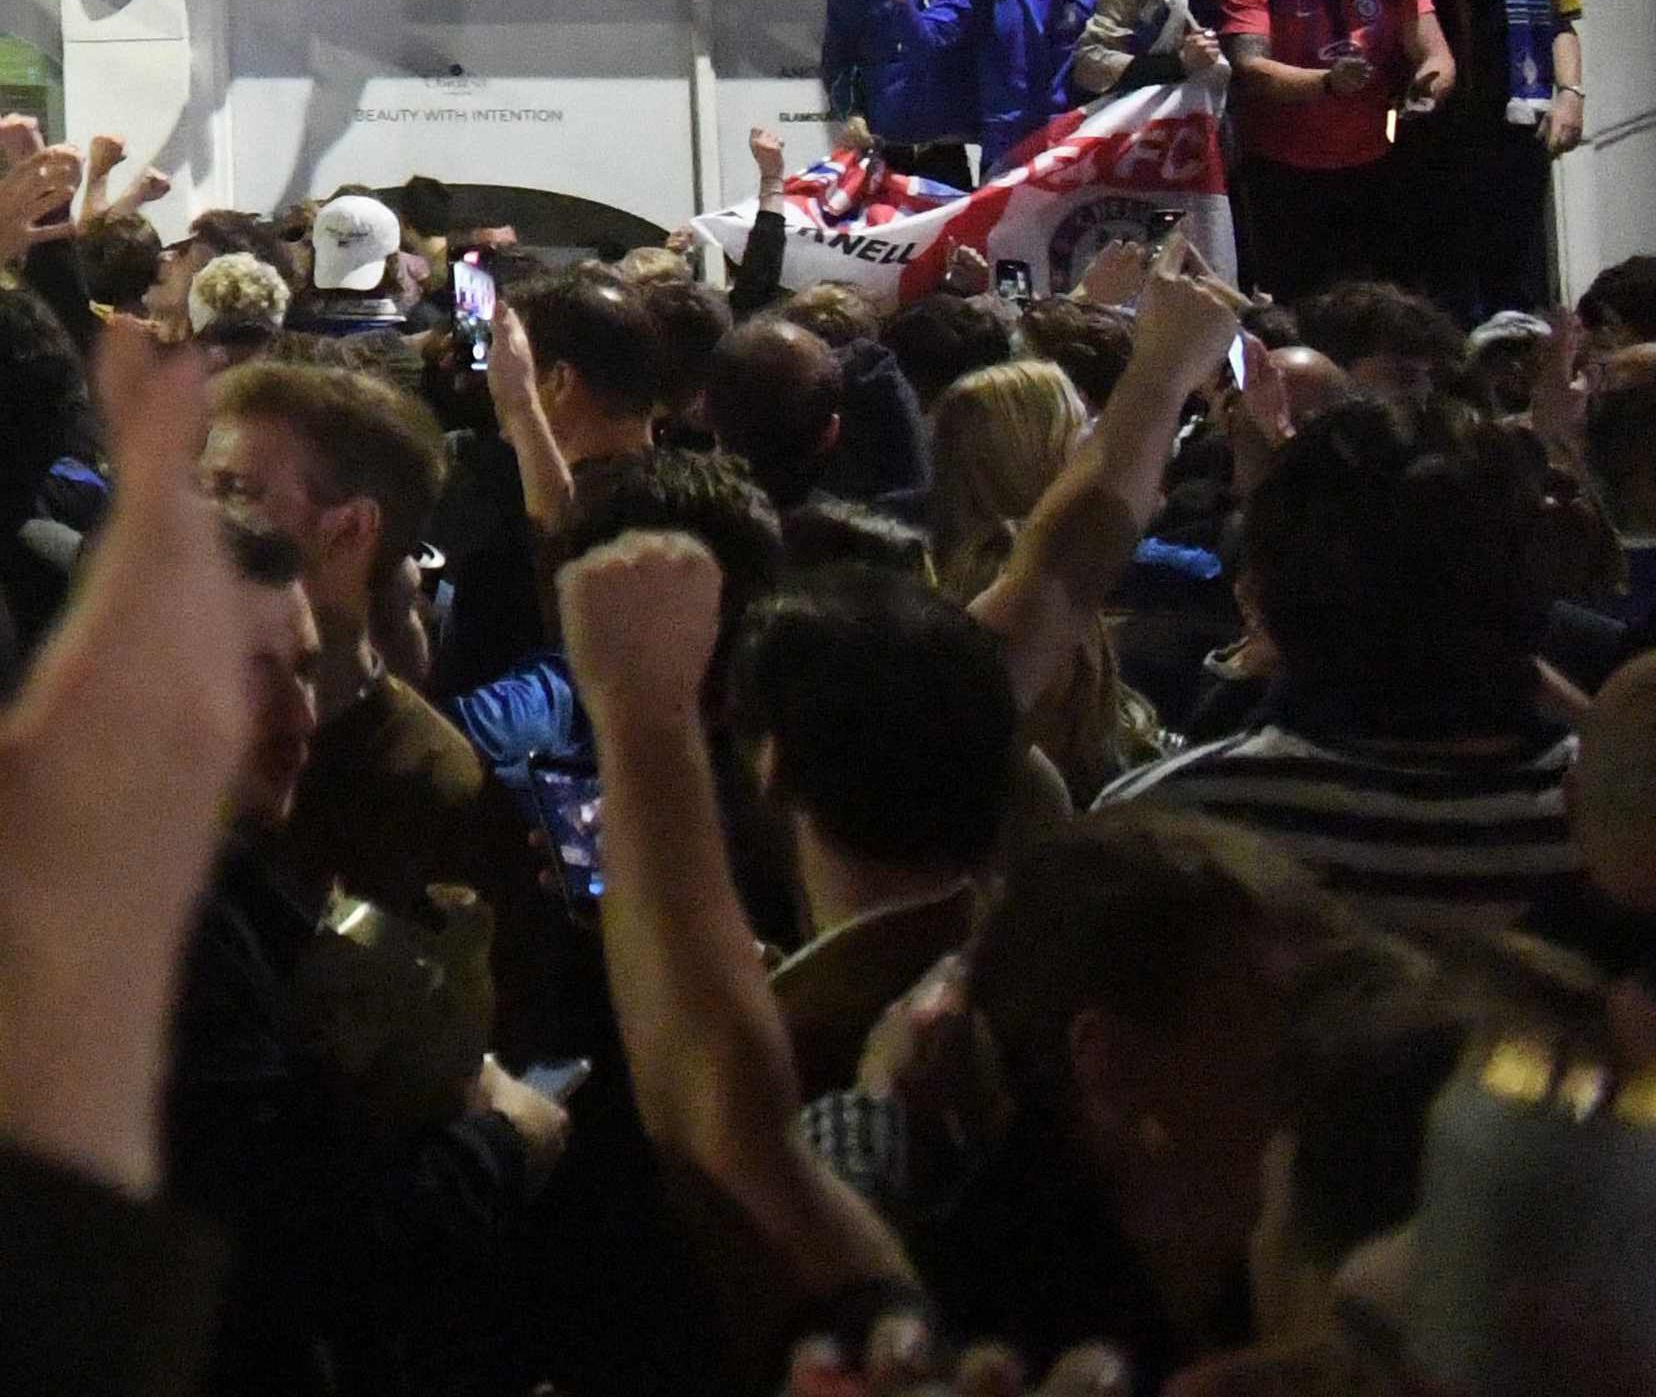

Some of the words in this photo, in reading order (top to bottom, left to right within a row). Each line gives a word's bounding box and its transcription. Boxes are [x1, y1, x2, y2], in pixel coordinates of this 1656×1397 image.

[354, 109, 417, 122] BEAUTY
[423, 109, 467, 122] WITH
[472, 109, 564, 122] INTENTION
